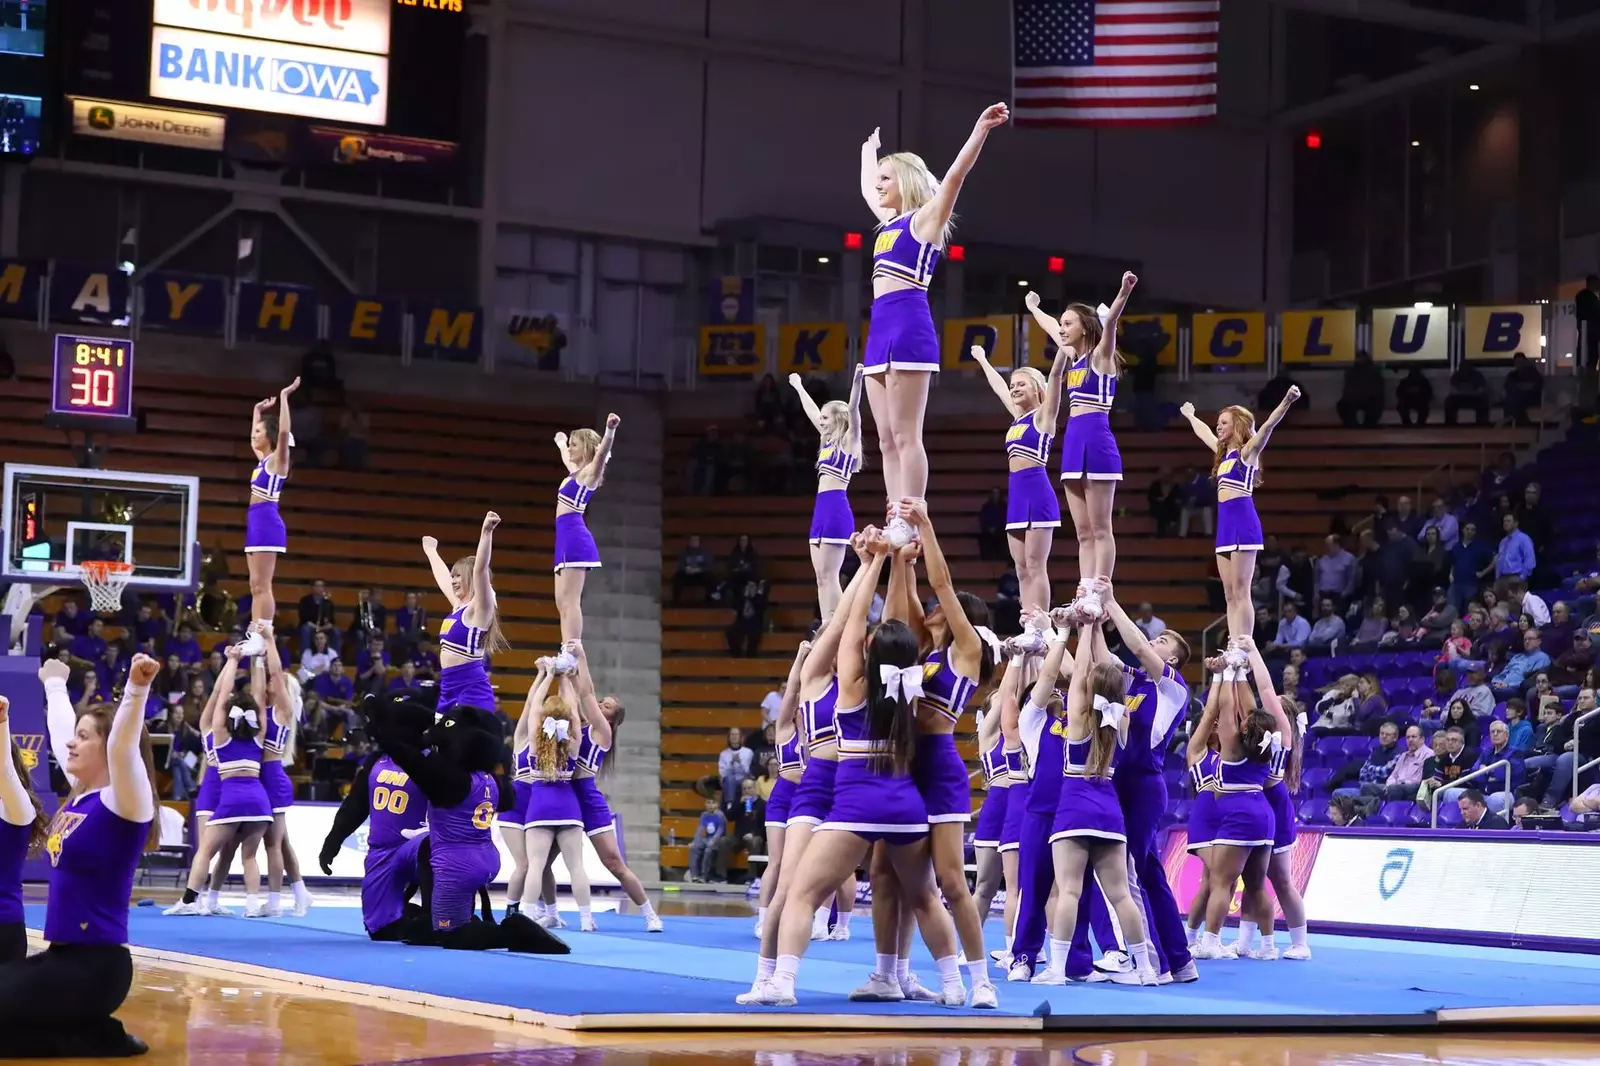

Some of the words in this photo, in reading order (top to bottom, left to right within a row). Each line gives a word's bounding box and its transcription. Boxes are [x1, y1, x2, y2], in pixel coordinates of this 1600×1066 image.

[159, 43, 264, 90] BANK
[272, 59, 367, 103] IOWA
[120, 114, 160, 131] JOHN
[162, 119, 212, 137] DEERE
[1208, 312, 1524, 358] CLUB
[76, 343, 125, 367] 8:41
[70, 367, 115, 407] 30
[11, 734, 45, 752] NI
[376, 769, 410, 787] UNI
[373, 786, 410, 815] 00
